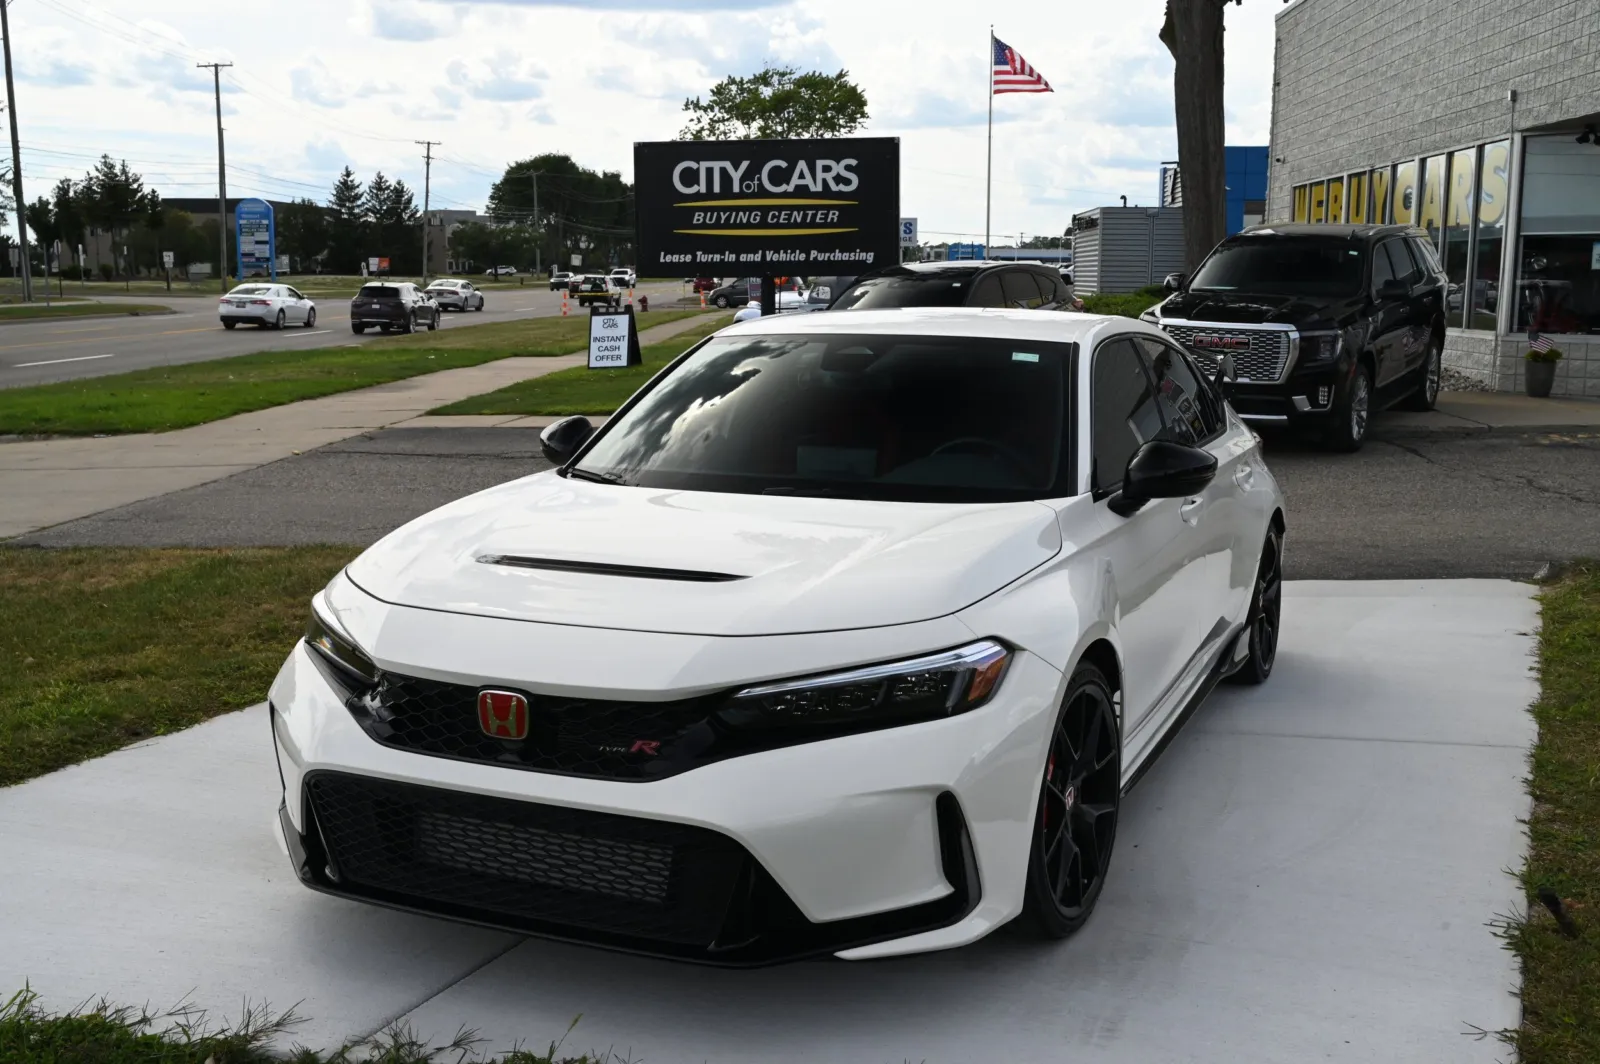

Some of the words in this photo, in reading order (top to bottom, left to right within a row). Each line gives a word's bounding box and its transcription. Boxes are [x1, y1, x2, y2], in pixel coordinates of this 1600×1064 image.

[672, 160, 750, 194] CITY
[743, 175, 760, 193] of
[761, 159, 859, 193] CARS
[1329, 170, 1389, 224] BUY
[1393, 146, 1508, 228] CARS
[693, 211, 761, 225] BUYING
[767, 210, 839, 223] CENTER
[660, 252, 692, 263] Lease
[696, 251, 736, 262] Turn-In
[739, 250, 762, 262] and
[765, 249, 806, 261] Vehicle
[810, 249, 874, 263] Purchasing
[1194, 335, 1250, 349] GMC
